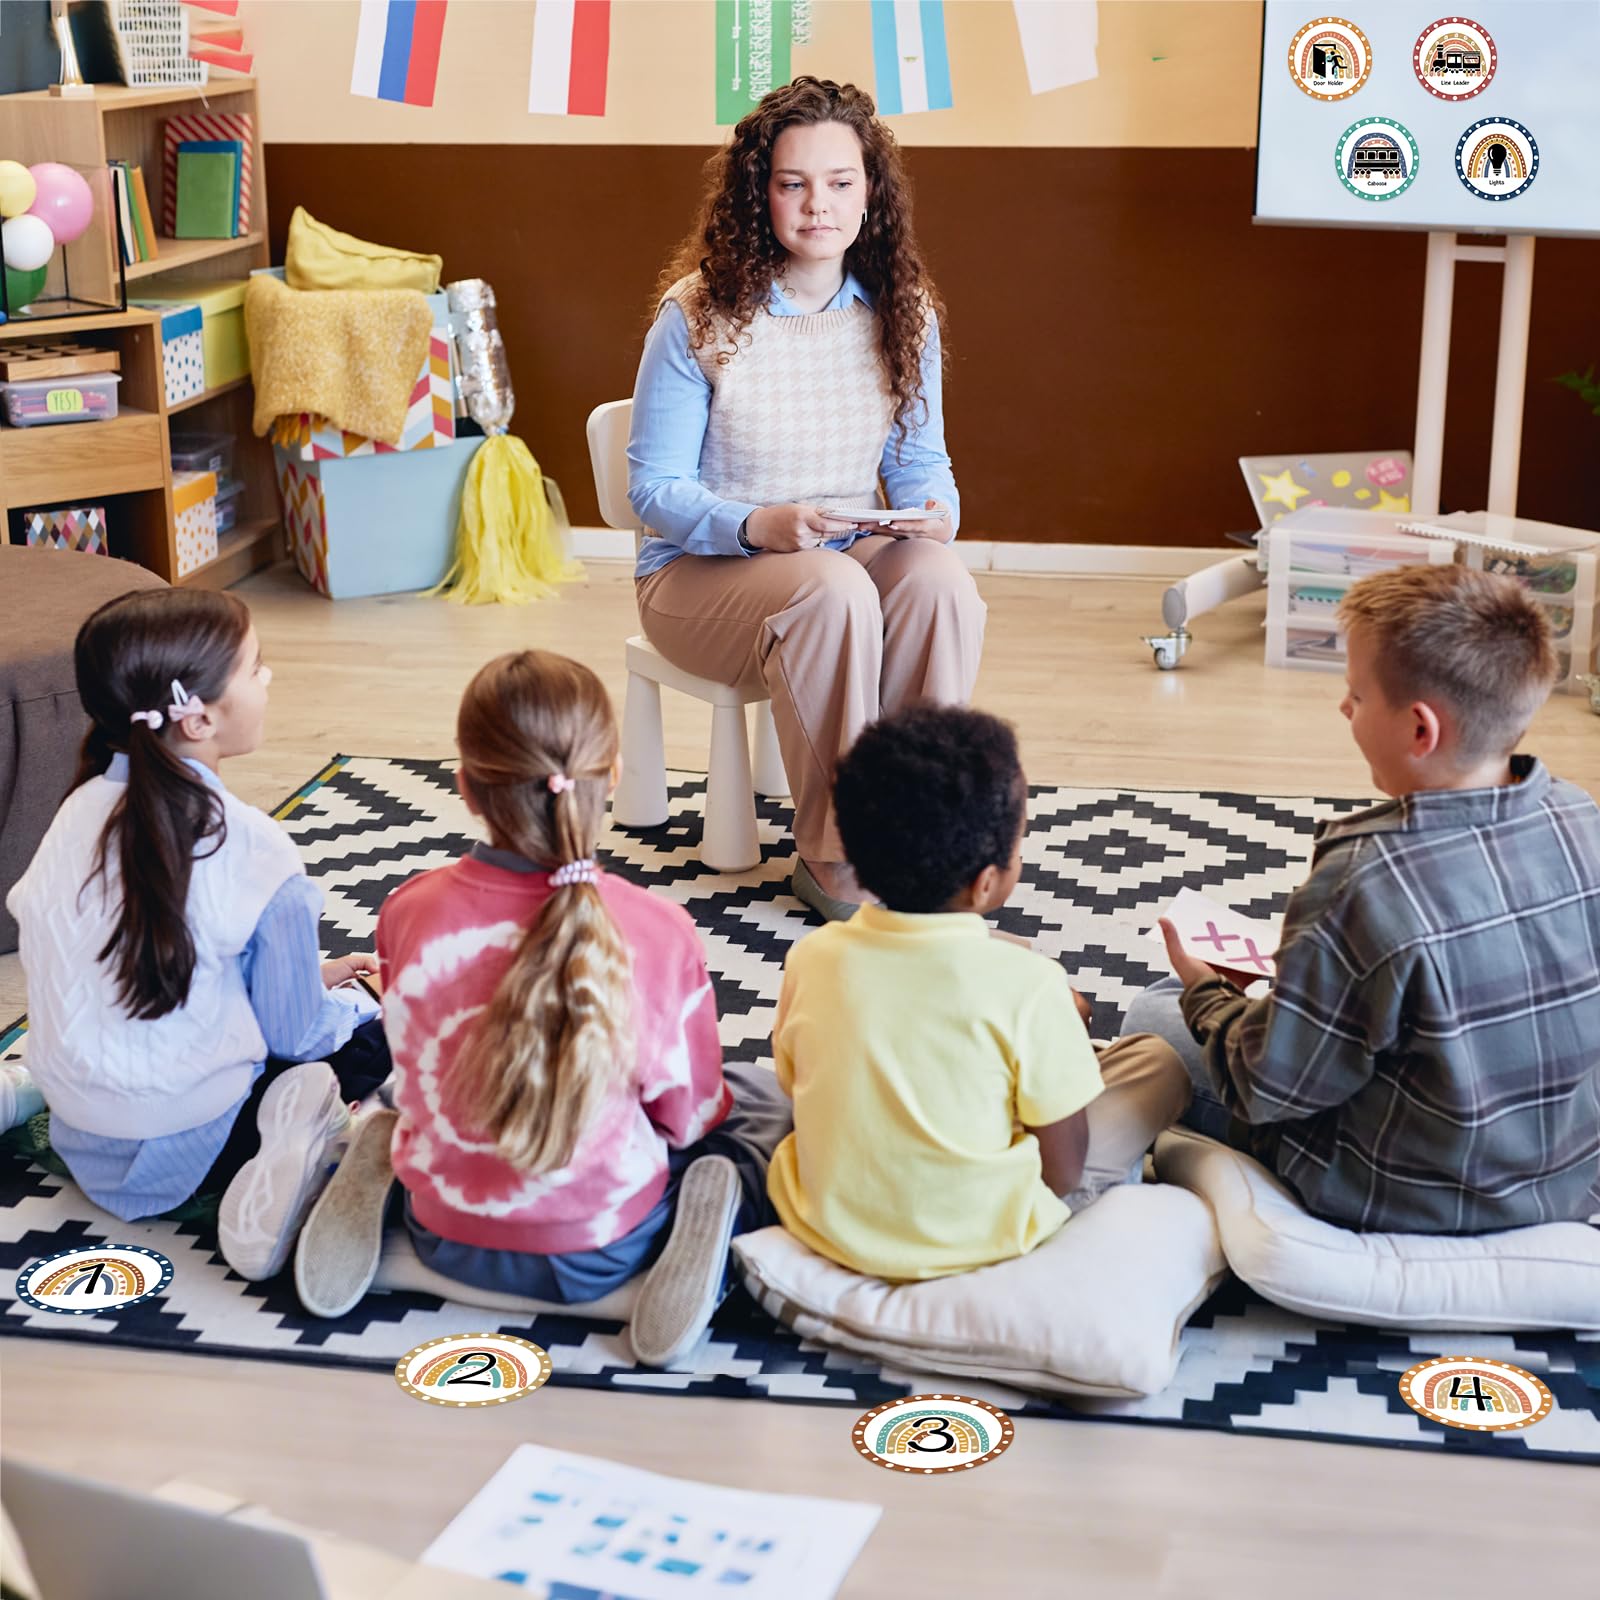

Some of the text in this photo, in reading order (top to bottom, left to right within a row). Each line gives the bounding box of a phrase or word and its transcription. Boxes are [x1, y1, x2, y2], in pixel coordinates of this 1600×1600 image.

[79, 1263, 106, 1294] 1
[447, 1352, 497, 1386] 2
[1449, 1376, 1493, 1411] 4
[907, 1417, 954, 1453] 3
